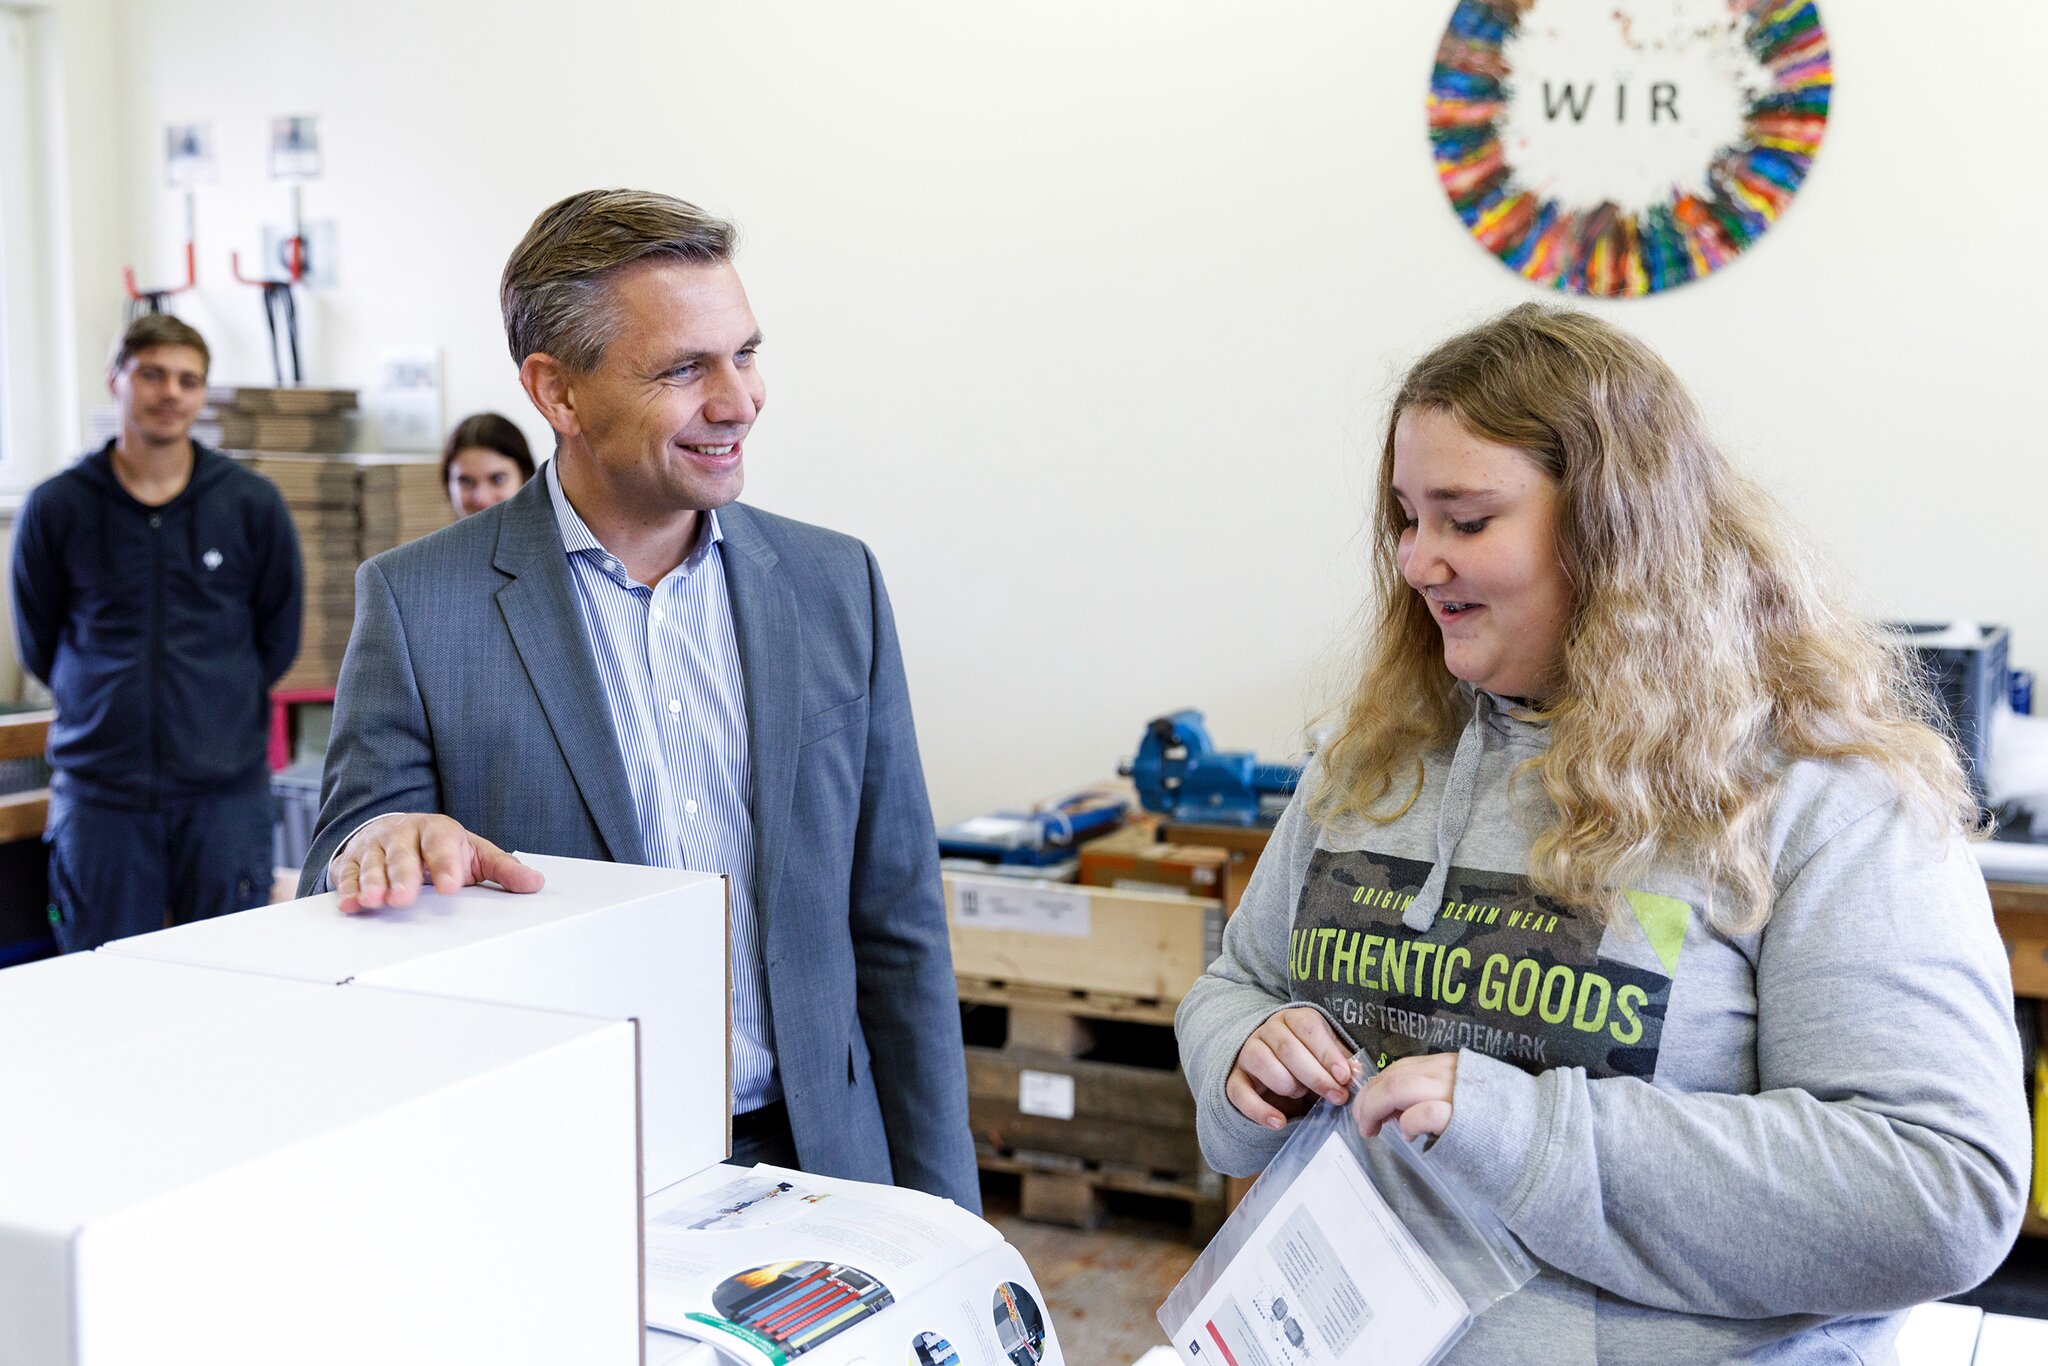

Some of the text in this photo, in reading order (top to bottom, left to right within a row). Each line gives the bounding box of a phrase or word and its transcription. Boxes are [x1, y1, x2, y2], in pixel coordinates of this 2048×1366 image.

[1542, 81, 1681, 123] WIR
[1352, 886, 1558, 933] ORIGIN DENIM WEAR
[1289, 927, 1649, 1045] AUTHENTIC GOODS
[1428, 1016, 1548, 1064] TRADEMARK
